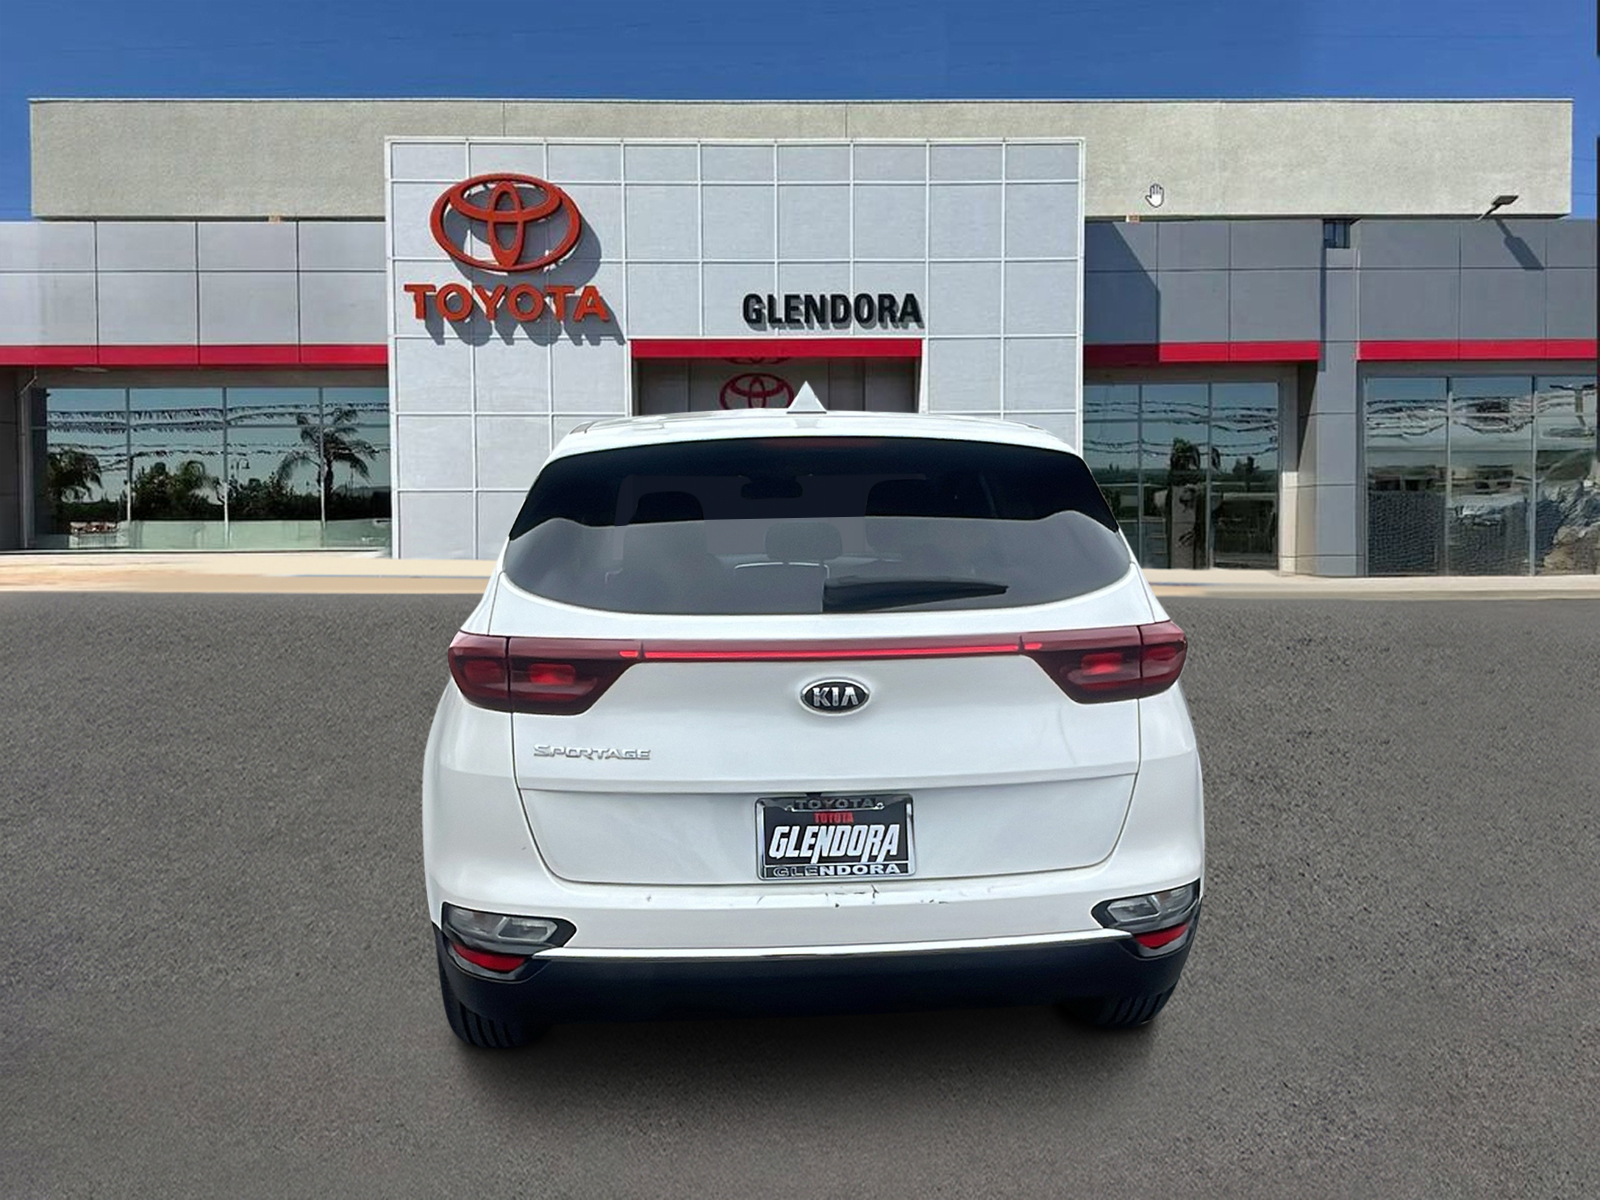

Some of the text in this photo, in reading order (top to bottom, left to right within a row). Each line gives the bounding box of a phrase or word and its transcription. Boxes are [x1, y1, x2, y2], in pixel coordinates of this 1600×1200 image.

[404, 284, 610, 323] TOYOTA
[743, 293, 923, 325] GLENDORA
[813, 686, 859, 707] KIA
[533, 744, 651, 761] SPORTAGE
[795, 798, 874, 810] TOYOTA
[814, 812, 854, 824] TOYOTA
[769, 824, 900, 864] GLENDORA
[773, 863, 900, 877] GLENDORA
